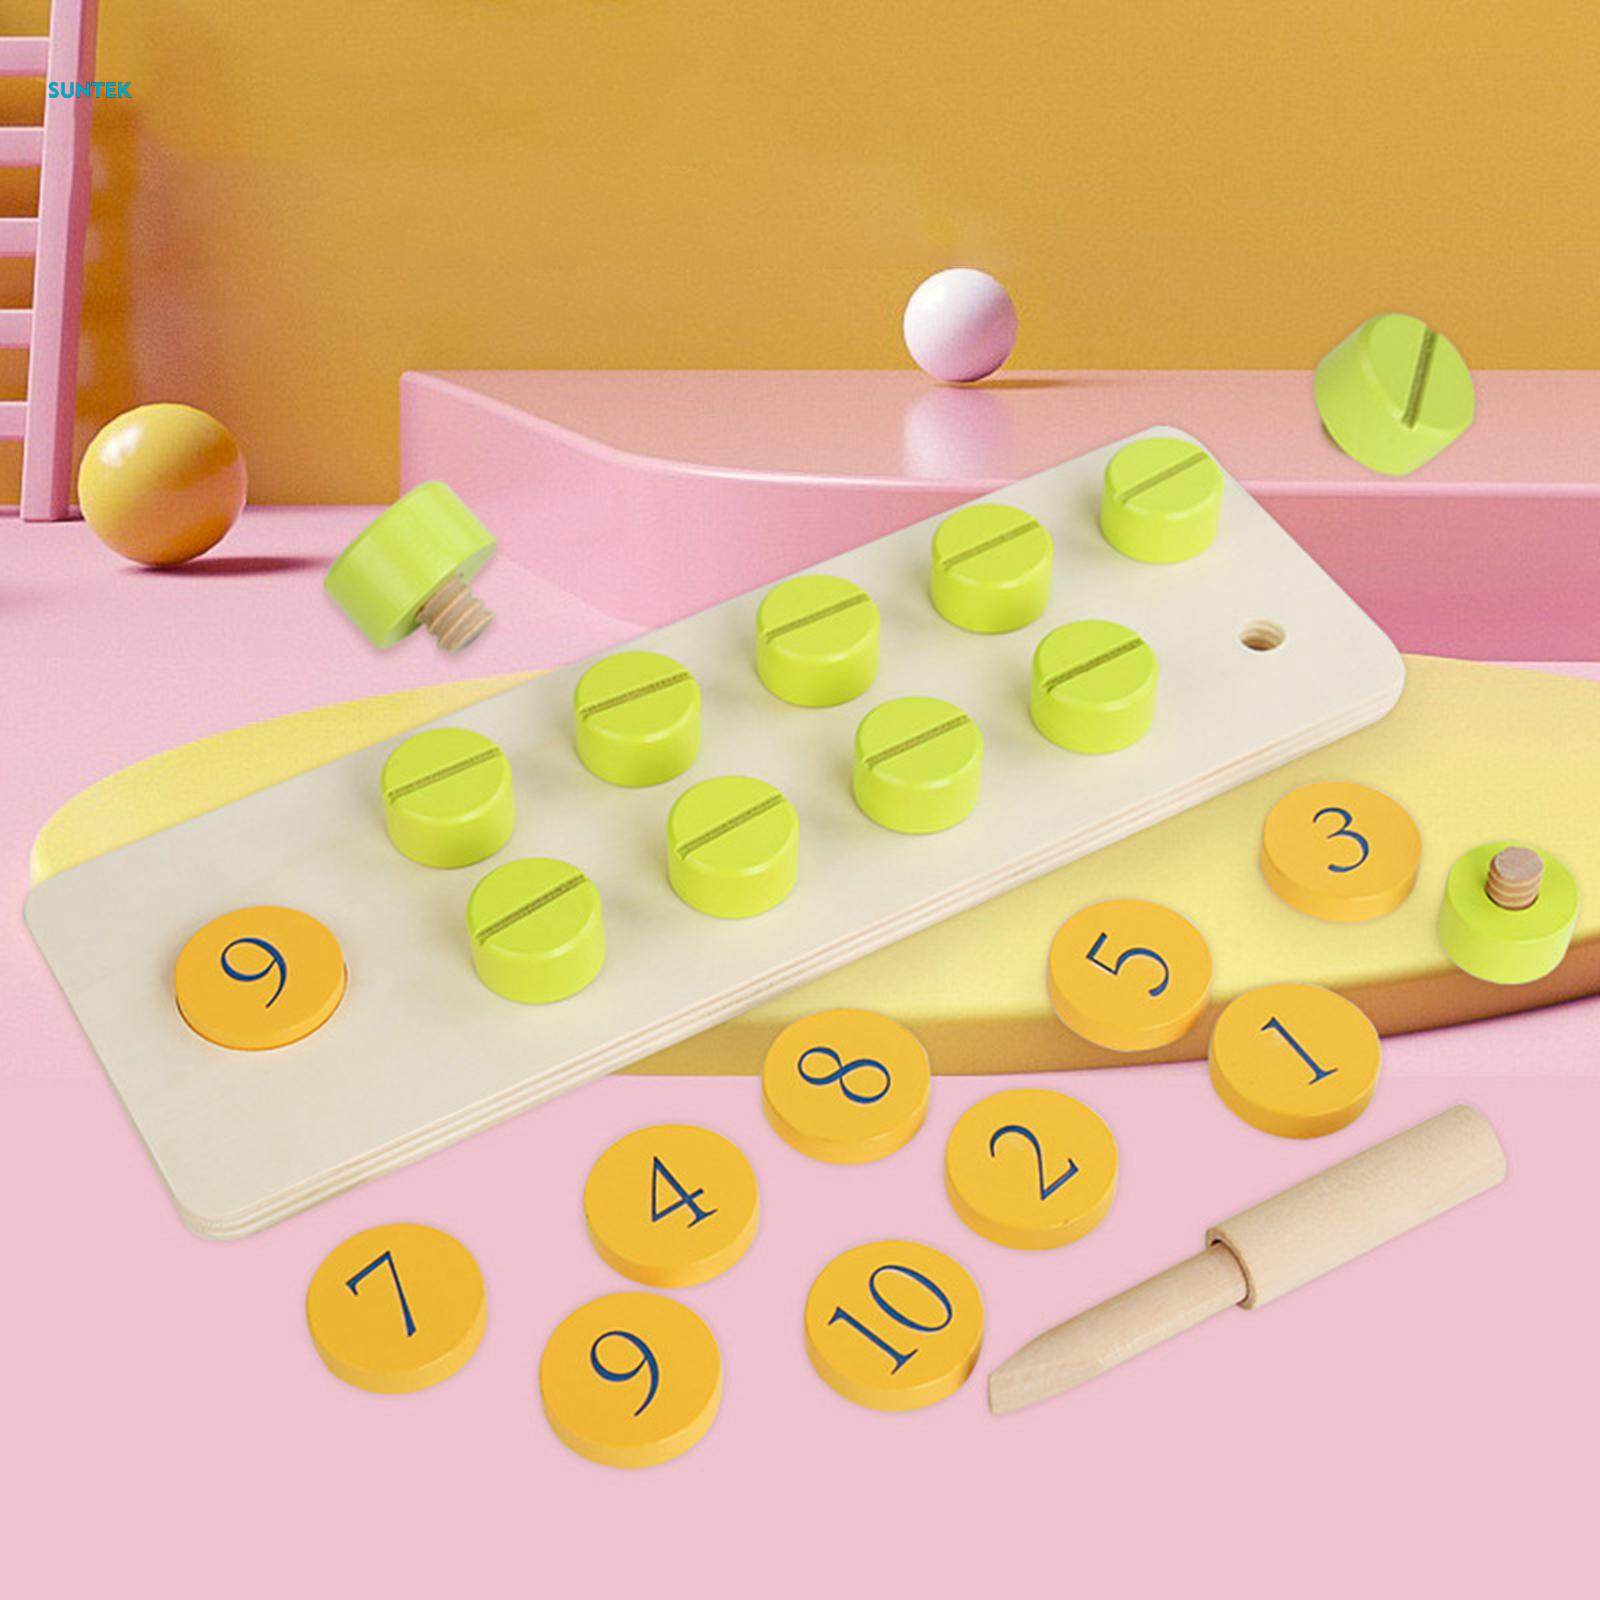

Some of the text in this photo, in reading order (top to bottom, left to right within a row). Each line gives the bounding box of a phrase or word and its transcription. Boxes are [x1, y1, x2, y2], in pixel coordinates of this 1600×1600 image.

[1312, 806, 1370, 874] 3
[220, 936, 288, 1008] 9
[1086, 932, 1170, 998] 5
[797, 1046, 892, 1105] 8
[1260, 1017, 1338, 1085] 1
[650, 1156, 718, 1229] 4
[989, 1124, 1080, 1201] 2
[346, 1251, 417, 1337] 7
[828, 1264, 954, 1375] 10
[589, 1330, 660, 1417] 9
